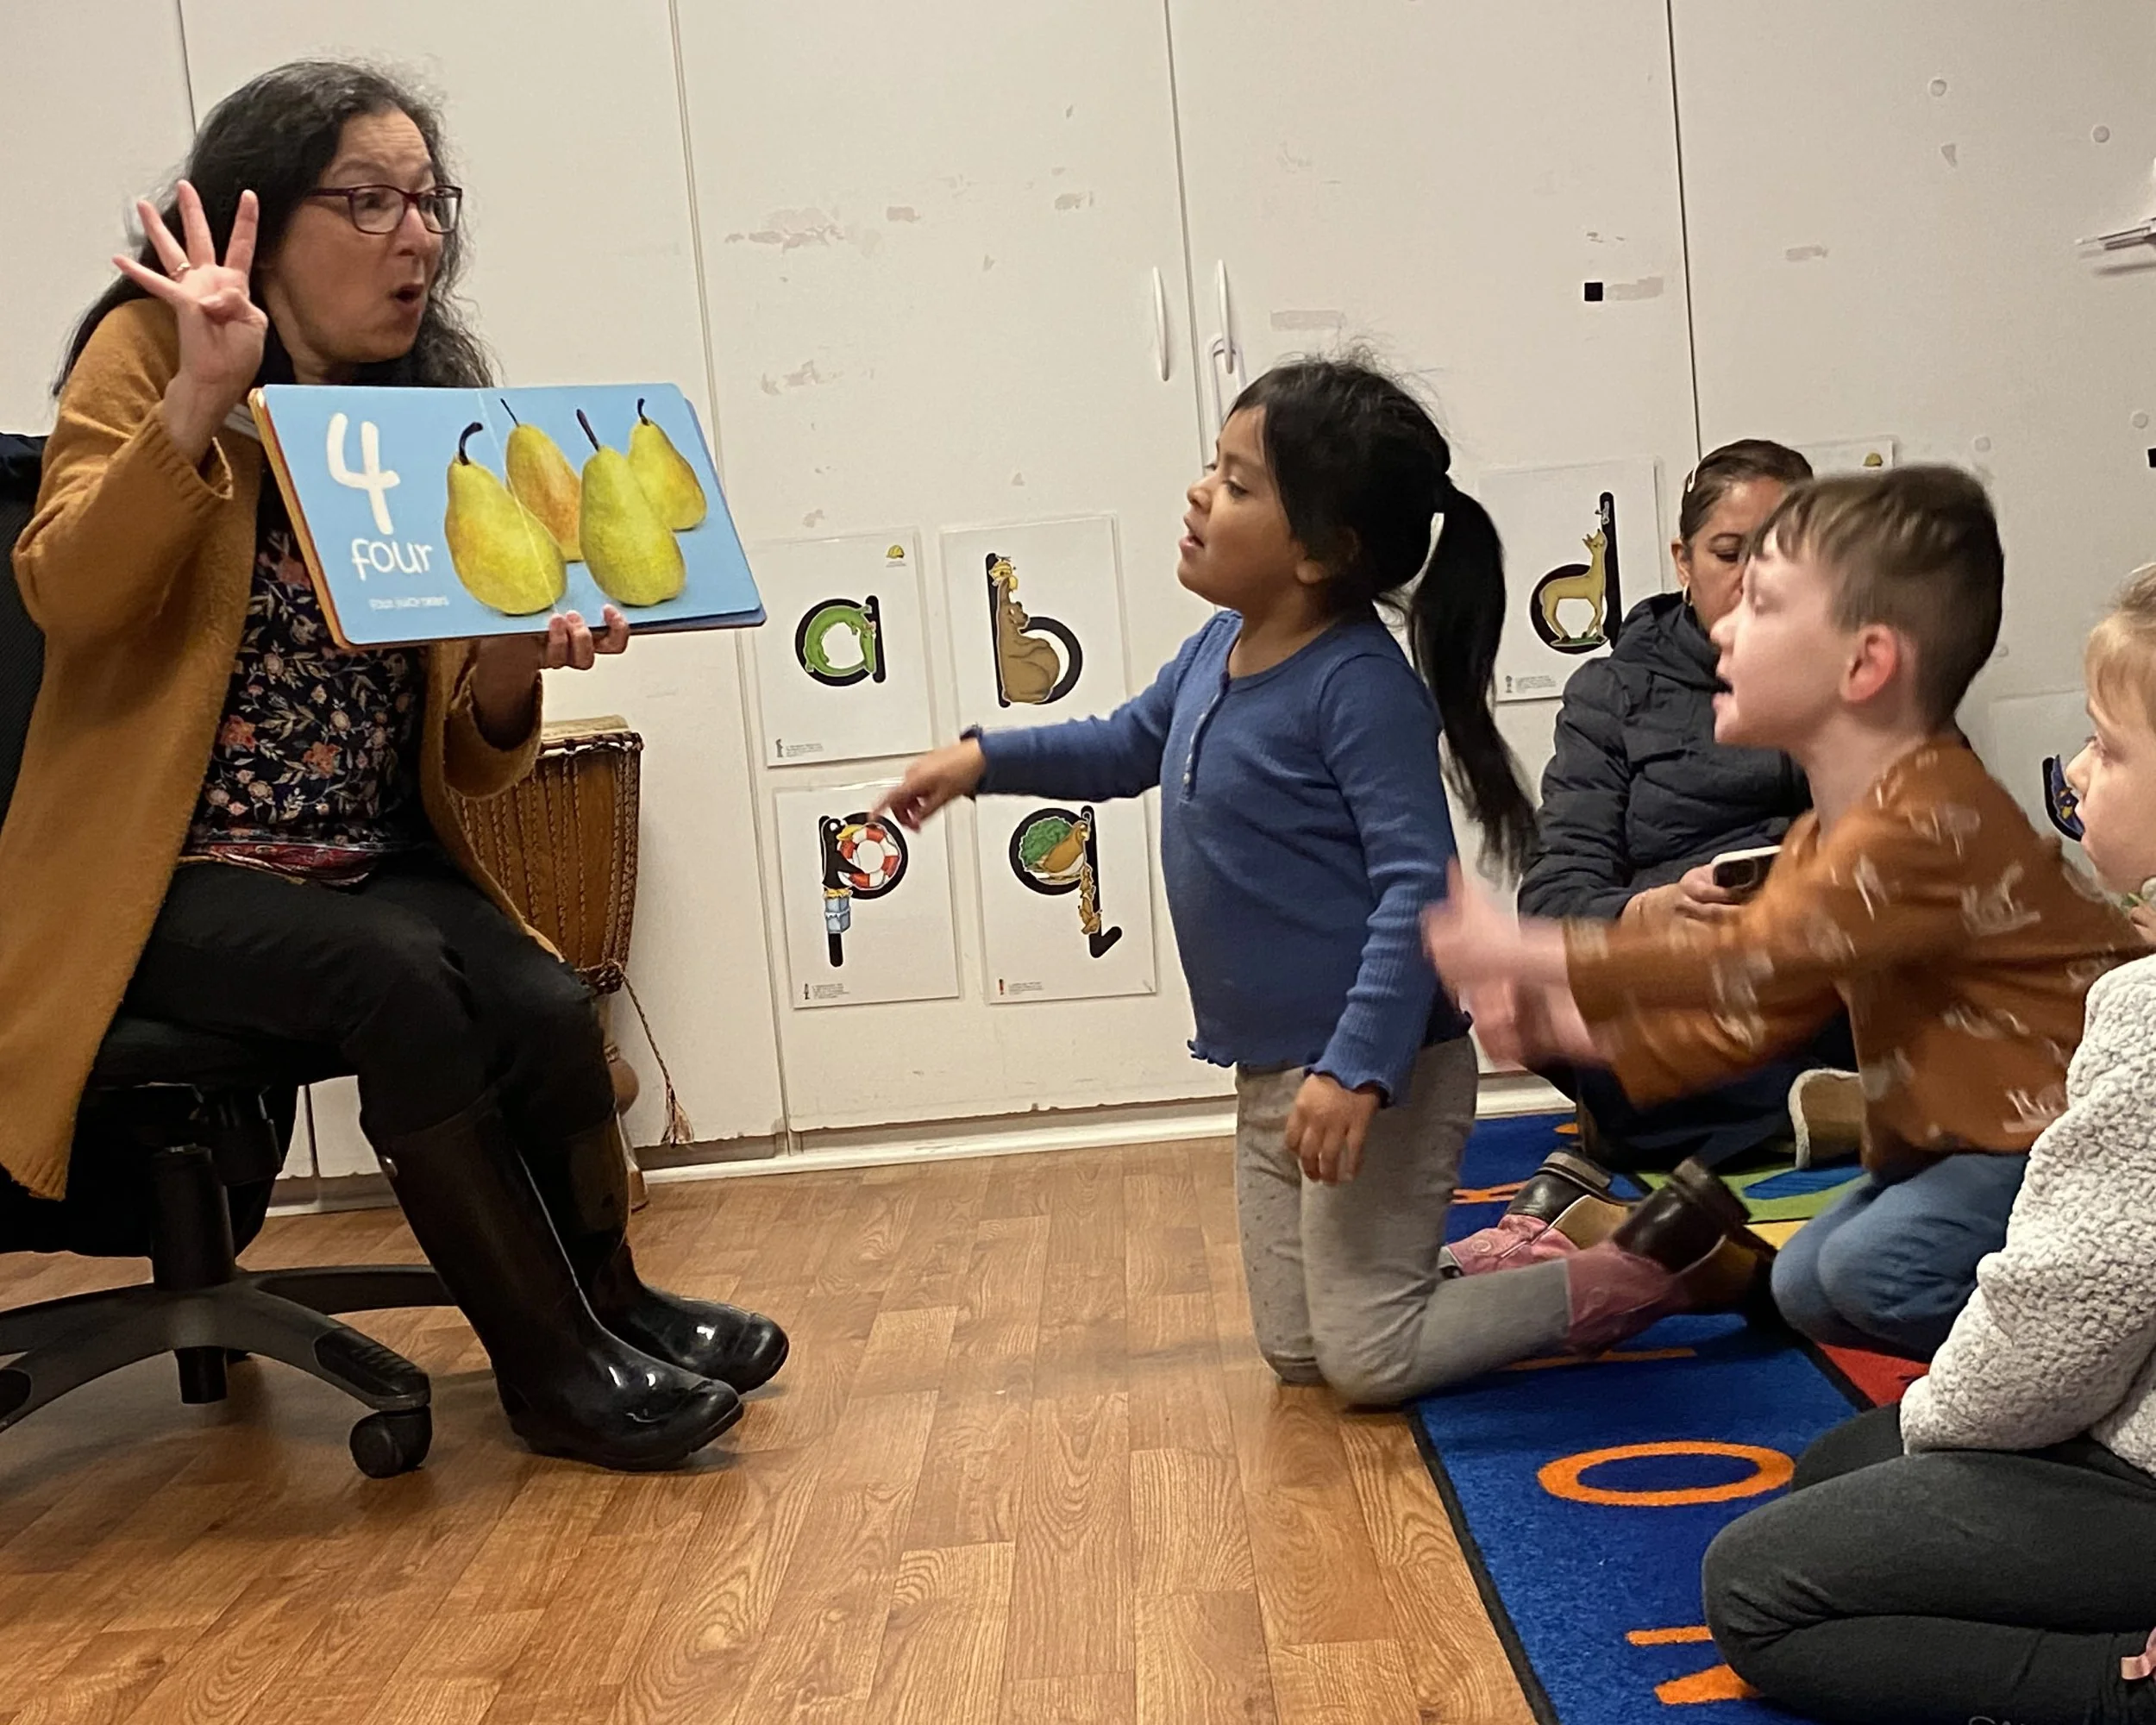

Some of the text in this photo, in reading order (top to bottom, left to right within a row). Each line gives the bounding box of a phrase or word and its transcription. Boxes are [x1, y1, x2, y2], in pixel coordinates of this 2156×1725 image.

[327, 413, 400, 535] 4
[351, 537, 433, 581] four
[985, 552, 1082, 707] b
[1531, 492, 1621, 654] d
[795, 595, 886, 687] a
[818, 811, 908, 967] p
[1009, 806, 1122, 958] q
